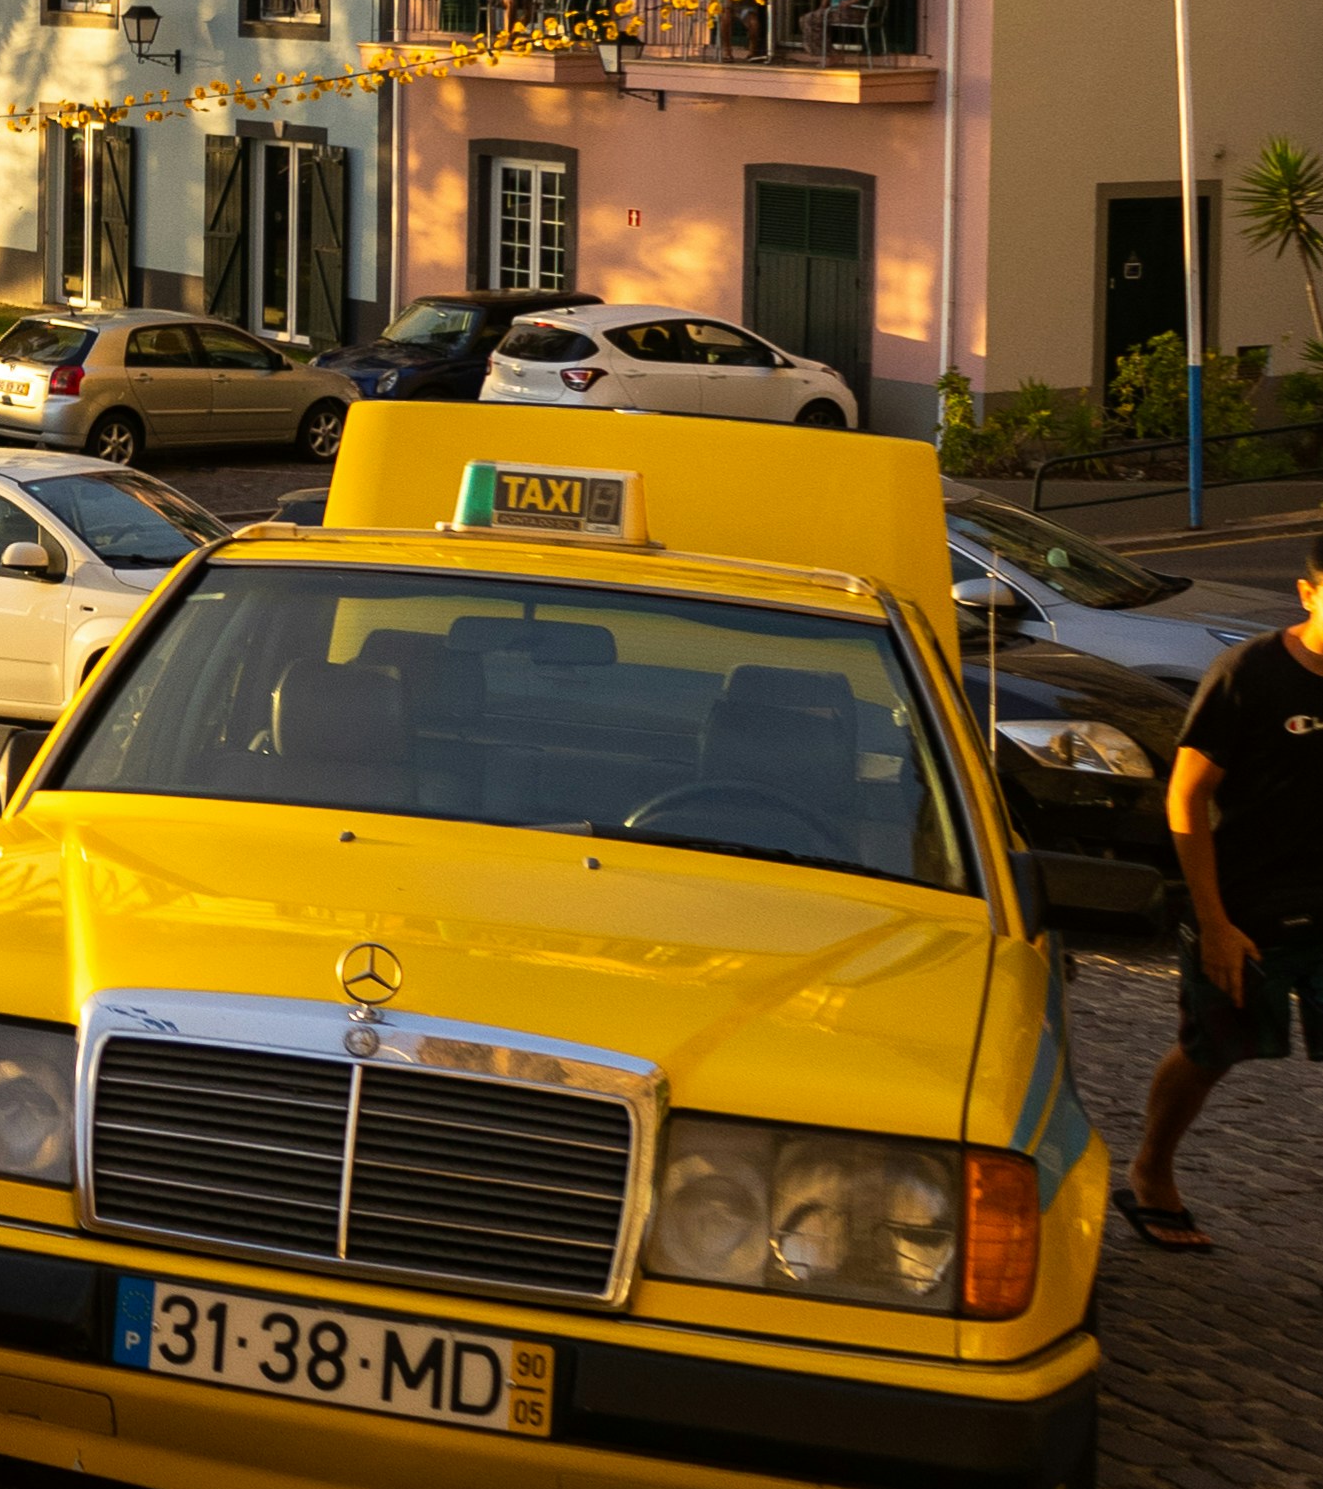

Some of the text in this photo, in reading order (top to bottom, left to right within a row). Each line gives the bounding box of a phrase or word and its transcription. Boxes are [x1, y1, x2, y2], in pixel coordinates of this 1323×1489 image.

[502, 475, 582, 514] TAXI
[124, 1330, 142, 1350] P
[516, 1352, 546, 1380] 90
[513, 1398, 544, 1427] 05
